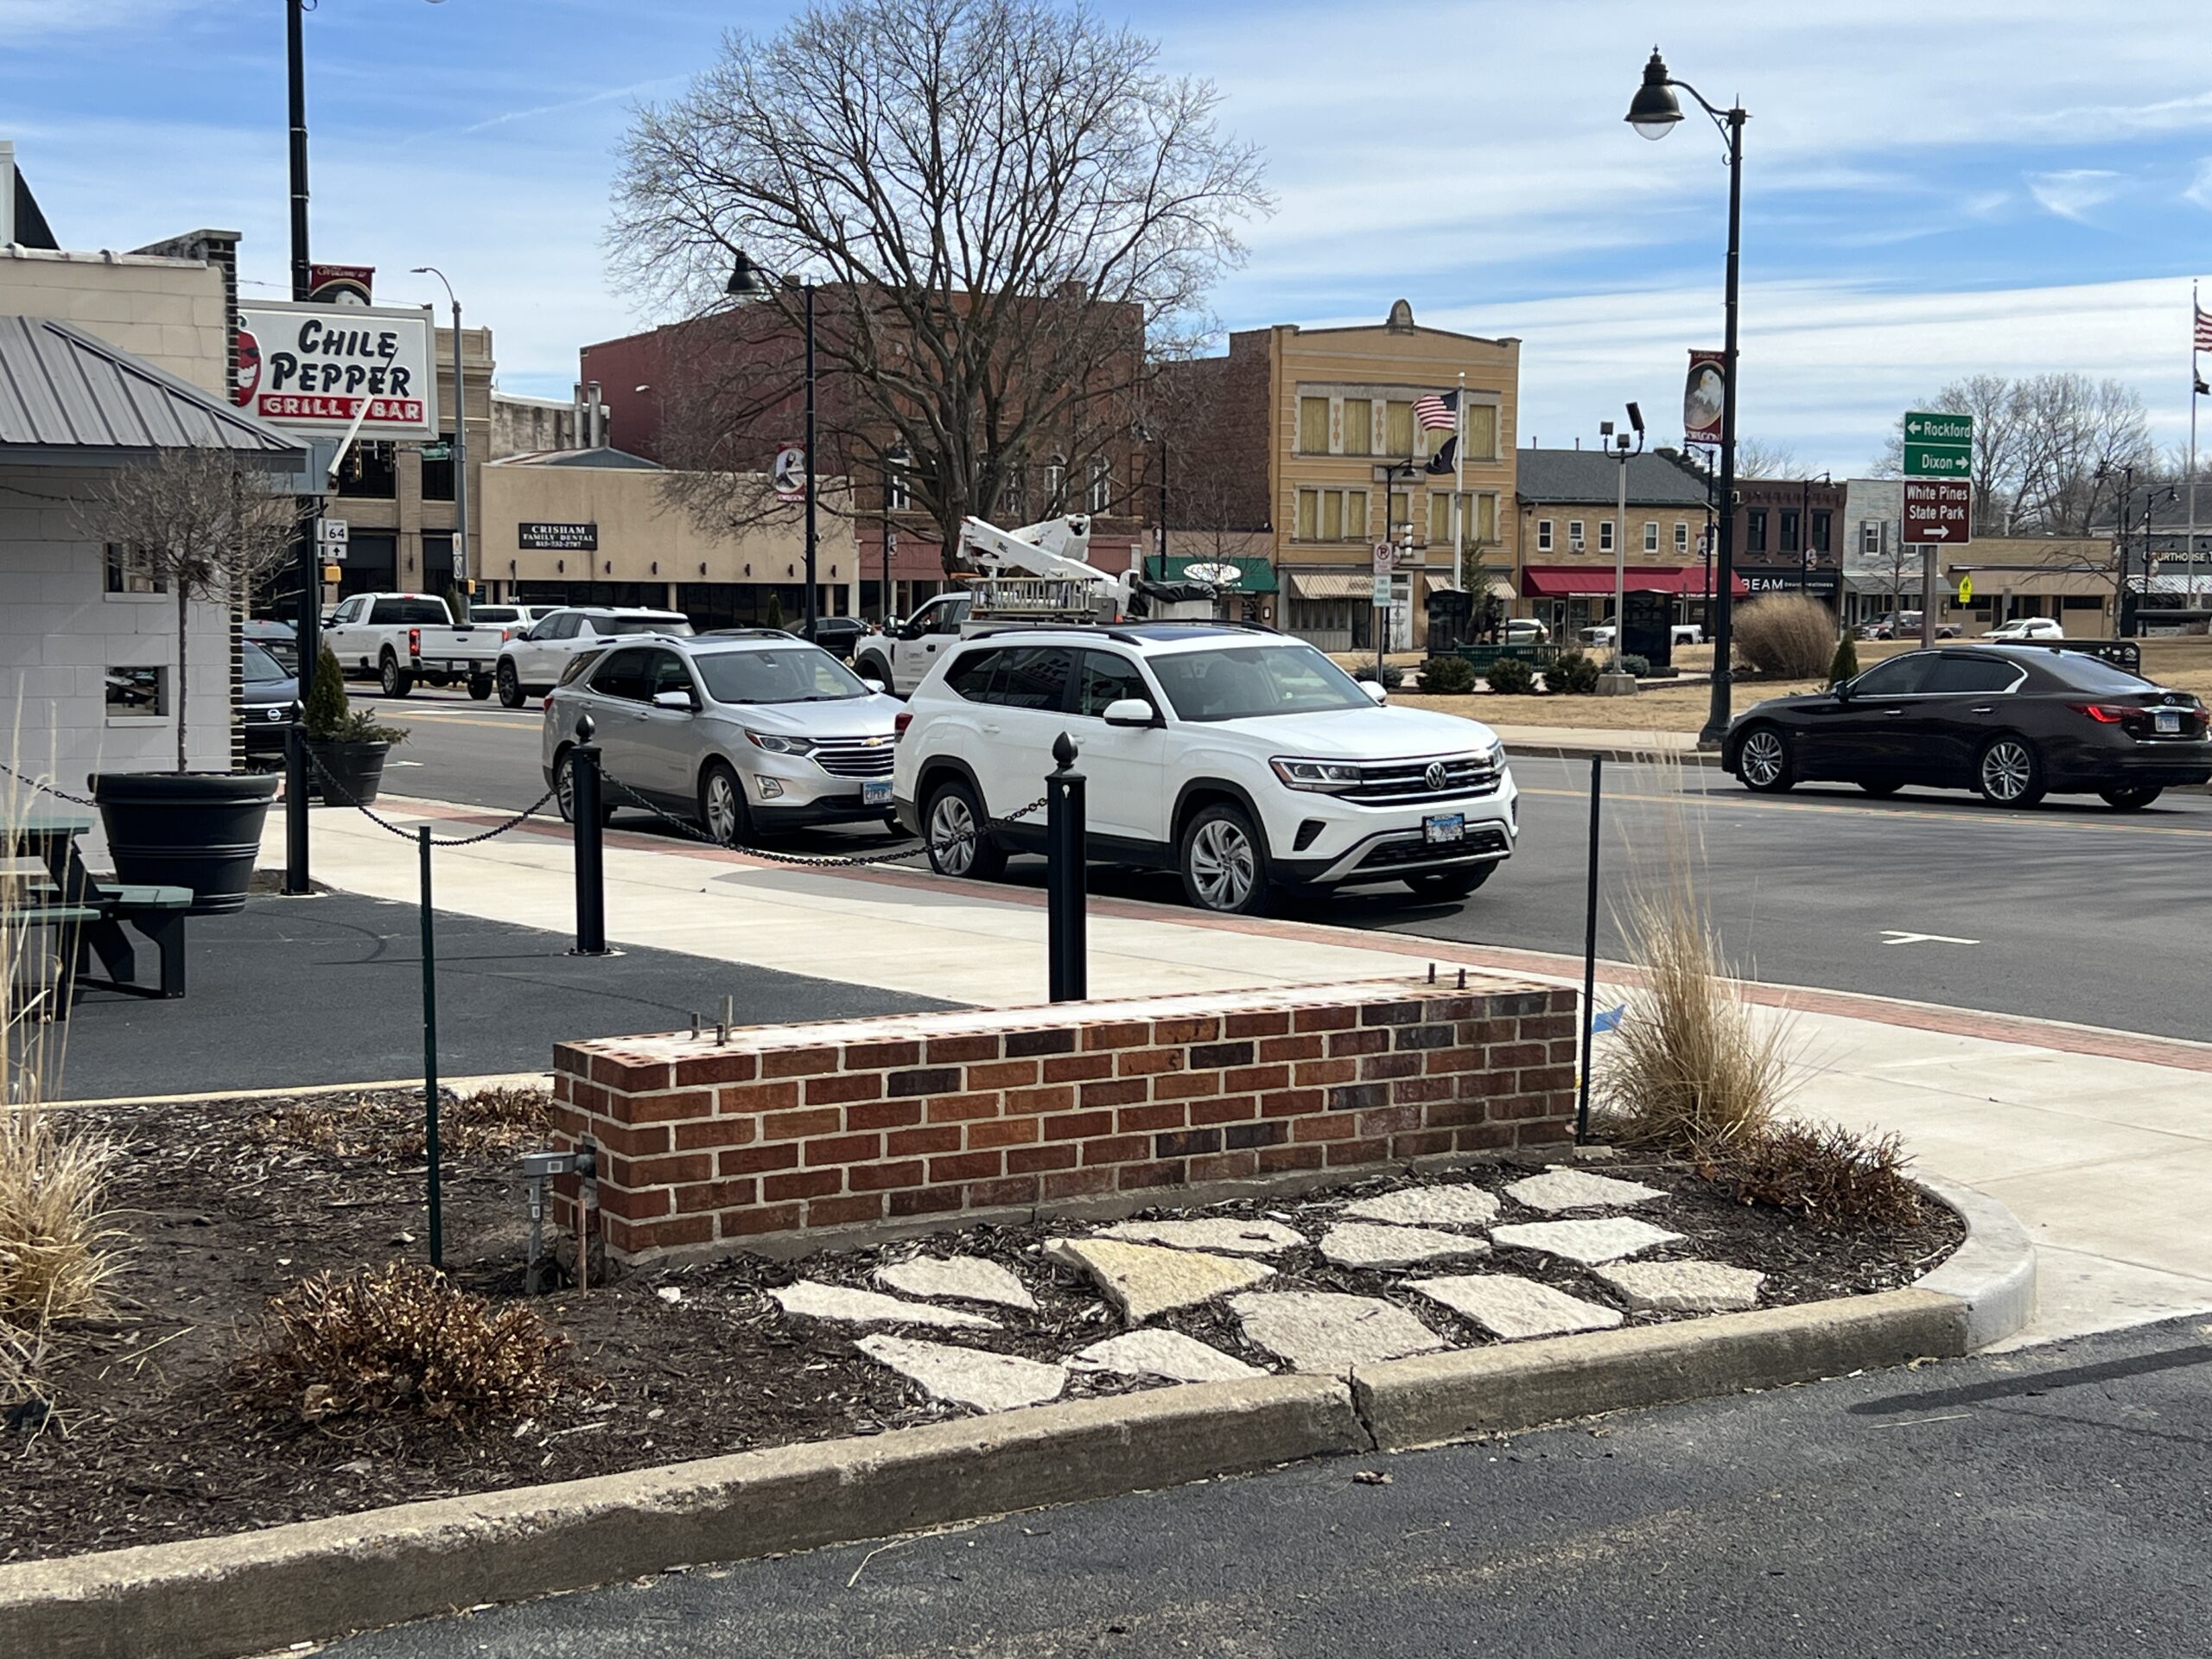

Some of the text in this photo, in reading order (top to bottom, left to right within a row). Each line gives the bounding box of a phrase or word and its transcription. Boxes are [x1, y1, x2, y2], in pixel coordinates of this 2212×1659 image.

[299, 319, 398, 358] CHILE
[270, 352, 410, 397] PEPPER
[264, 397, 344, 416] GRILL
[372, 401, 420, 420] BAR
[1923, 421, 1971, 438] Rockford
[1922, 454, 1953, 469] Dixon
[1907, 484, 1967, 501] White Pines
[1909, 505, 1965, 520] State Park
[329, 528, 345, 539] 64
[531, 525, 586, 534] CRISHAM
